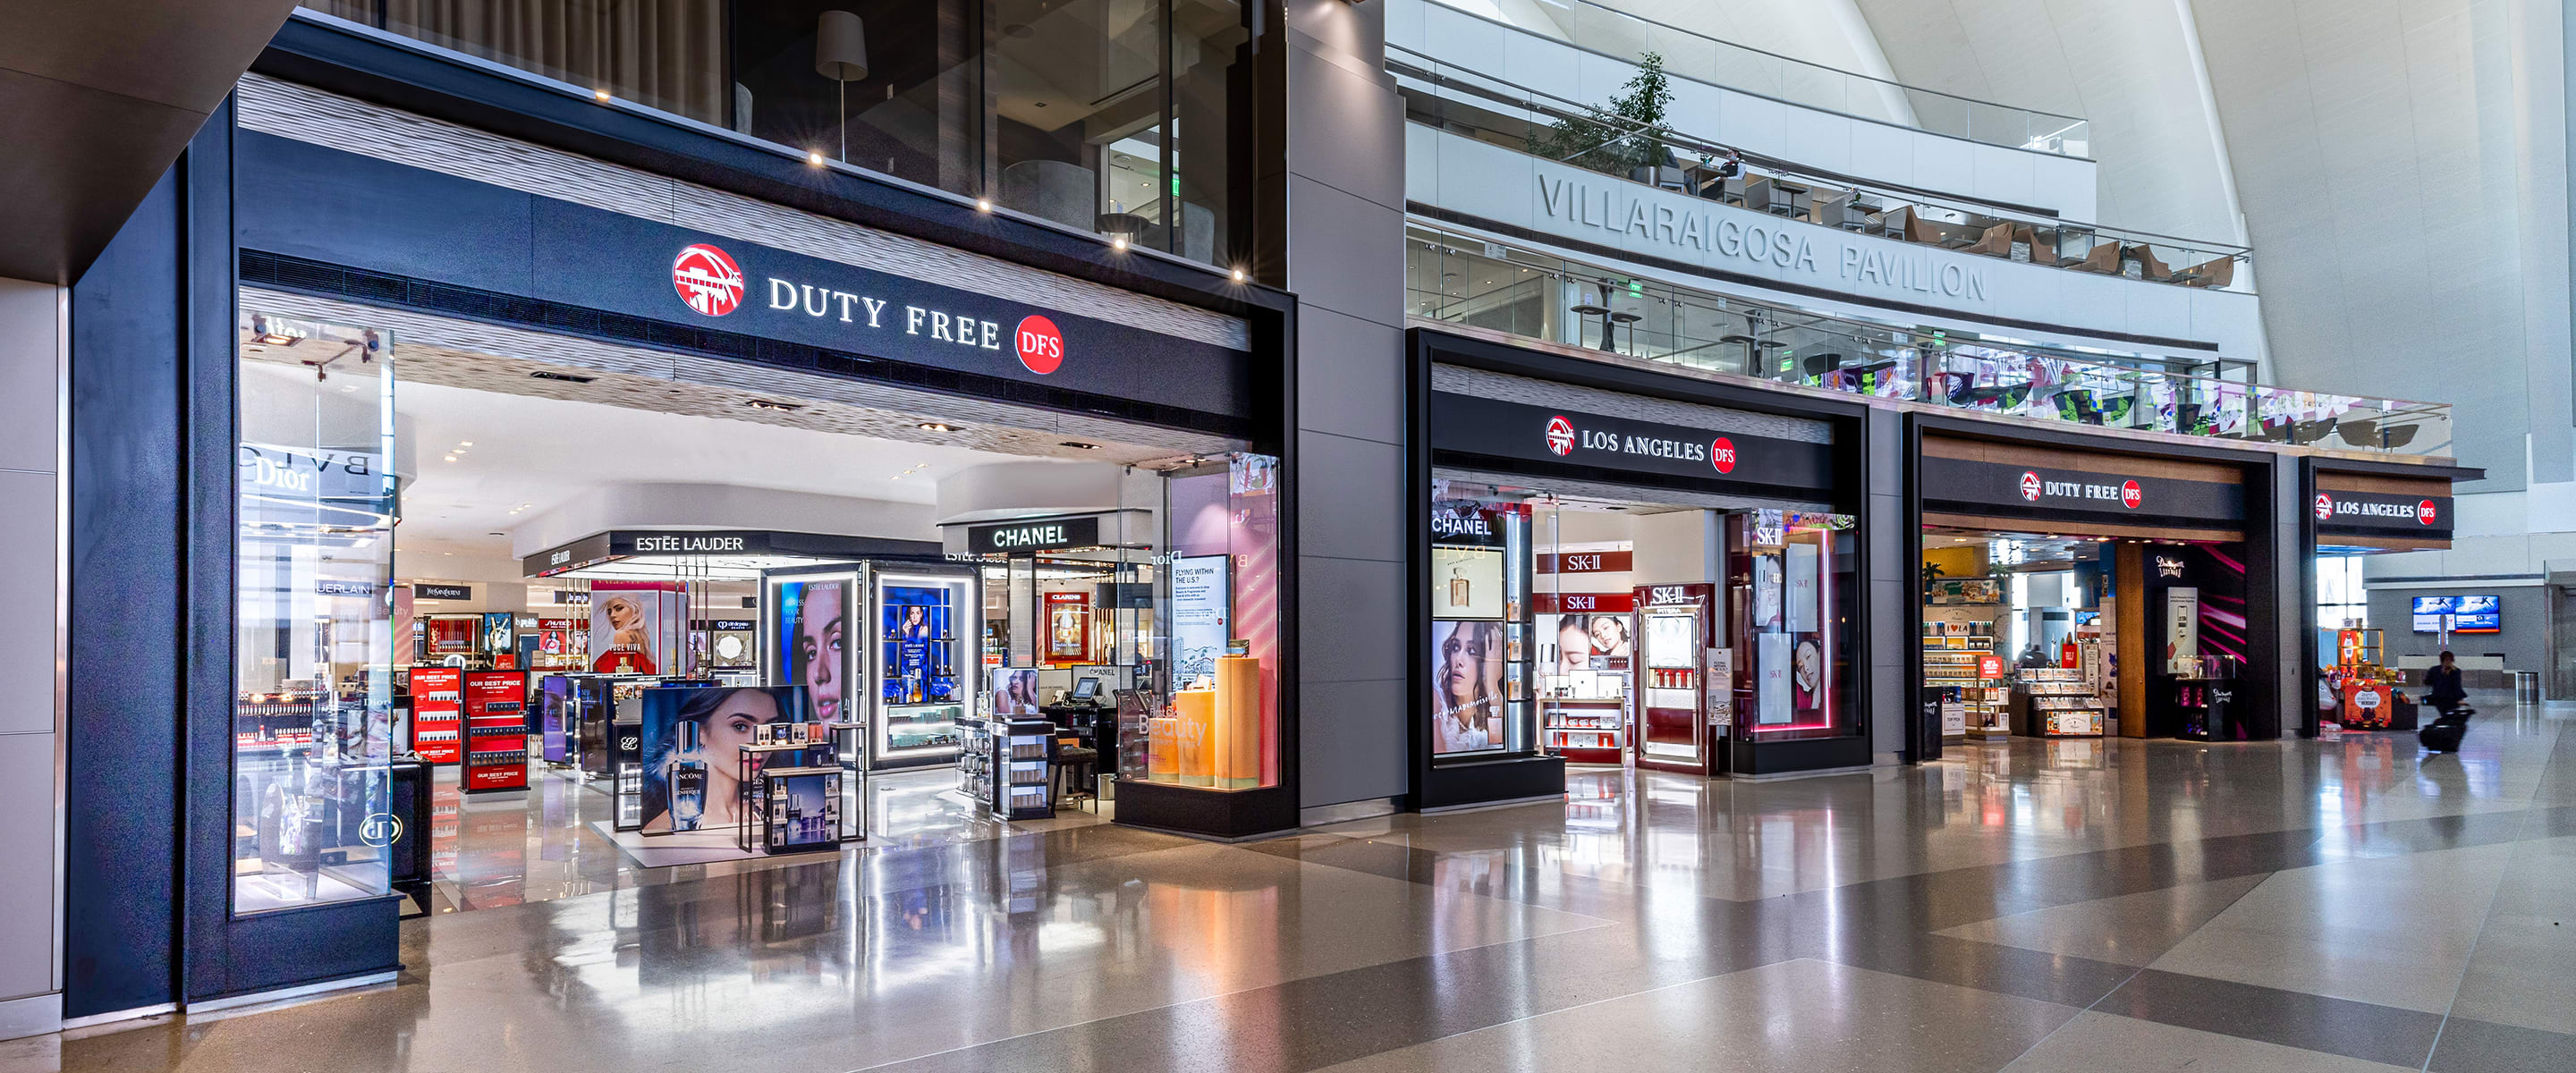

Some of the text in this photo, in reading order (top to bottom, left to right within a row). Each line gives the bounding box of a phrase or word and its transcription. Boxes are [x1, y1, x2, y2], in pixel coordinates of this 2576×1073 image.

[1538, 173, 1987, 301] VILLARAIGOSA PAVILION
[767, 277, 1061, 359] DUTY FREE DFS
[1582, 429, 1734, 464] LOS ANGELES DFS
[254, 456, 309, 491] Dior
[2045, 480, 2140, 501] DUTY FREE DFS
[2335, 500, 2435, 519] LOS ANGELES DFS
[1432, 517, 1492, 536] CHANEL
[1757, 527, 1782, 545] SK-II
[636, 536, 743, 551] ESTÉE LAUDER
[994, 526, 1068, 547] CHANEL
[1568, 554, 1601, 570] SK-II
[1567, 596, 1596, 610] SK-II
[1652, 587, 1684, 604] SK-II
[364, 697, 387, 706] Dior
[1139, 714, 1207, 746] Beauty
